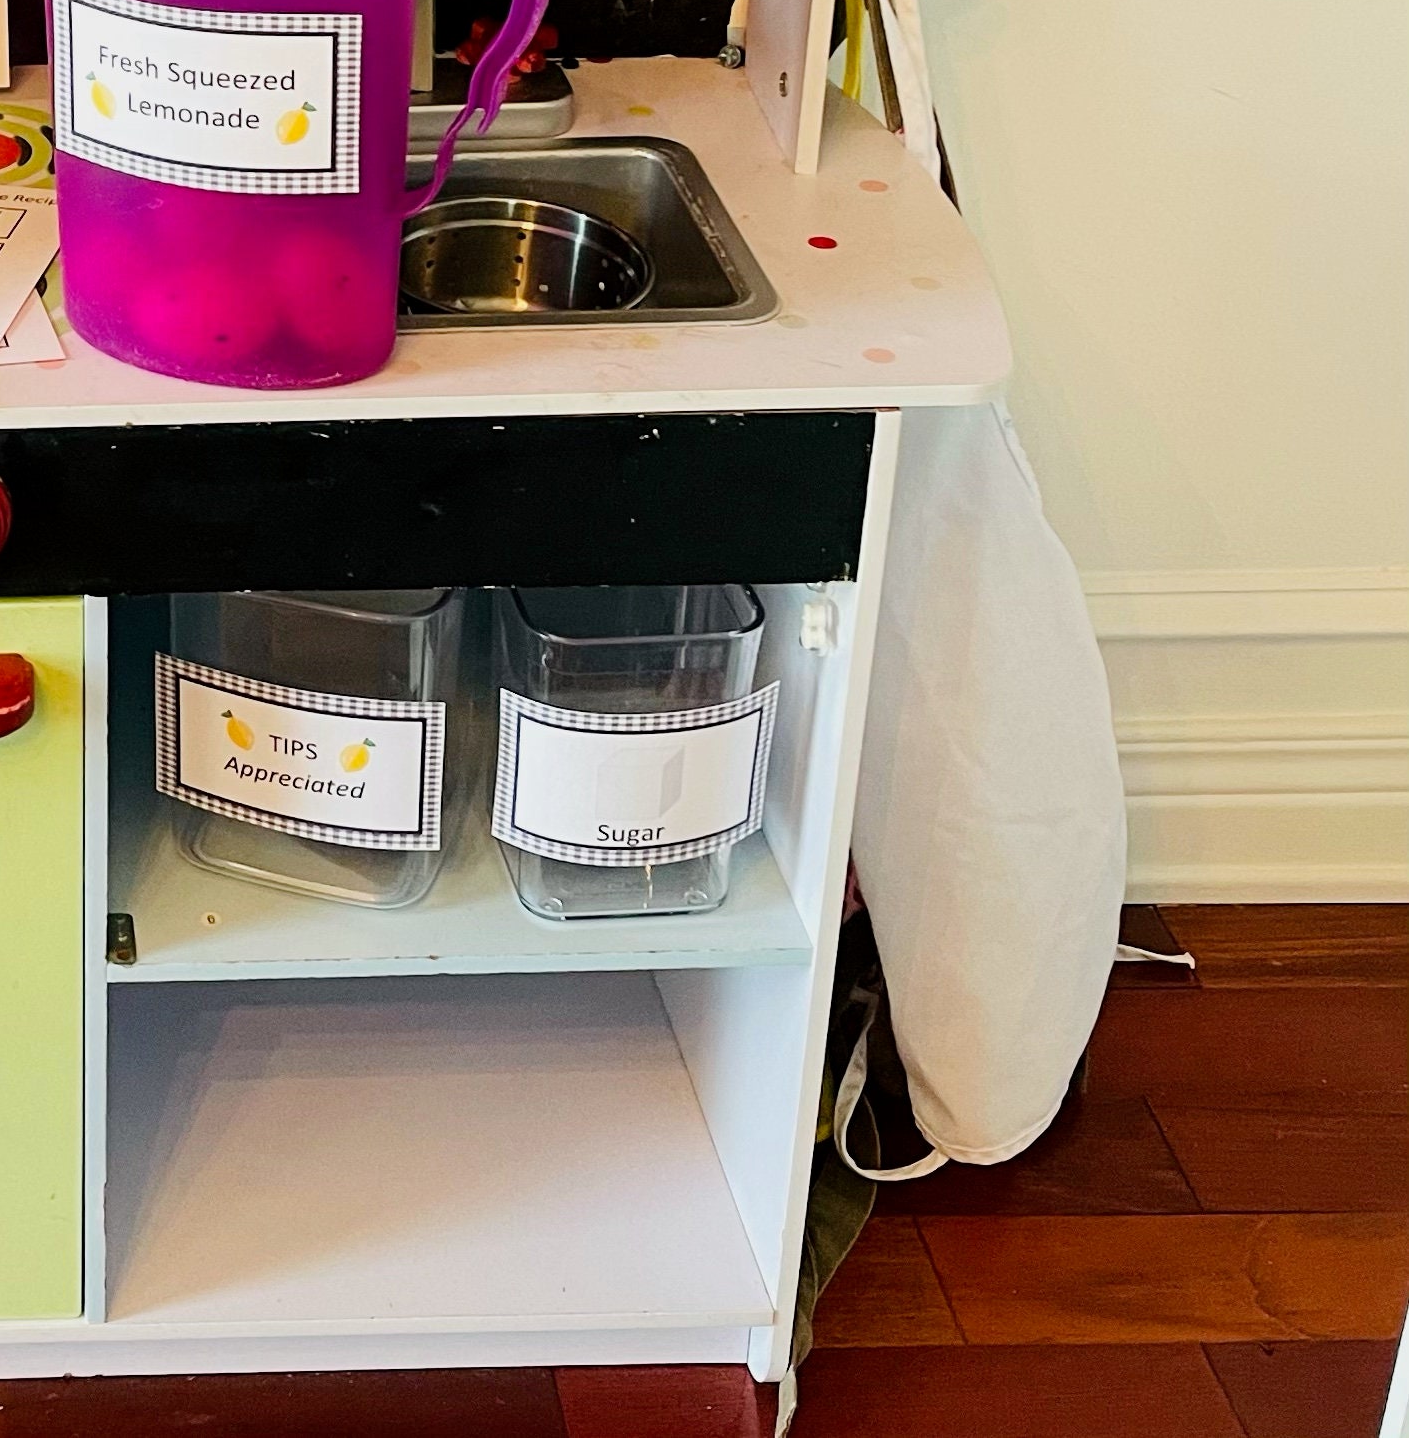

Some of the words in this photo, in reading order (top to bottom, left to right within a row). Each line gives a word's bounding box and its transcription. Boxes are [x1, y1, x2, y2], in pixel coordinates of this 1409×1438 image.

[98, 45, 159, 79] Fresh
[167, 62, 296, 91] Squeezed
[128, 92, 260, 129] Lemonade
[13, 194, 57, 206] Recip
[269, 734, 318, 760] TIPS
[224, 756, 366, 799] Appreciated
[596, 824, 666, 846] Sugar
